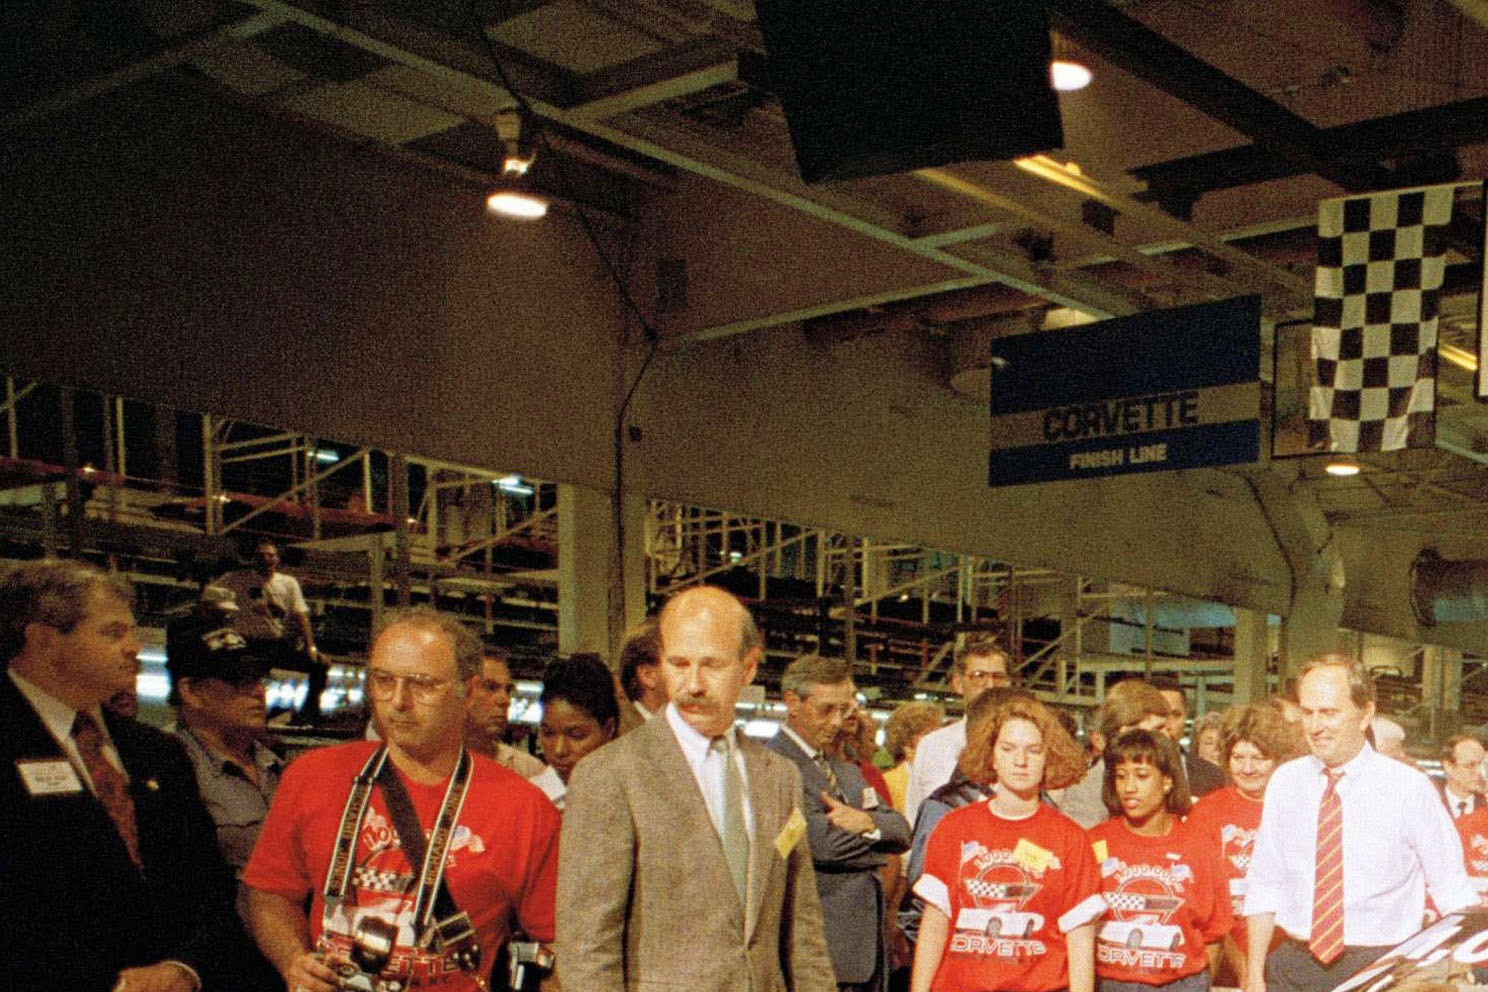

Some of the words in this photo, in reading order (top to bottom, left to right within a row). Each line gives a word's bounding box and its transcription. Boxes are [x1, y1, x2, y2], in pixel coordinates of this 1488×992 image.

[1043, 390, 1201, 441] CORVETTE
[1069, 447, 1124, 471] FINISH
[1130, 443, 1168, 464] LINE
